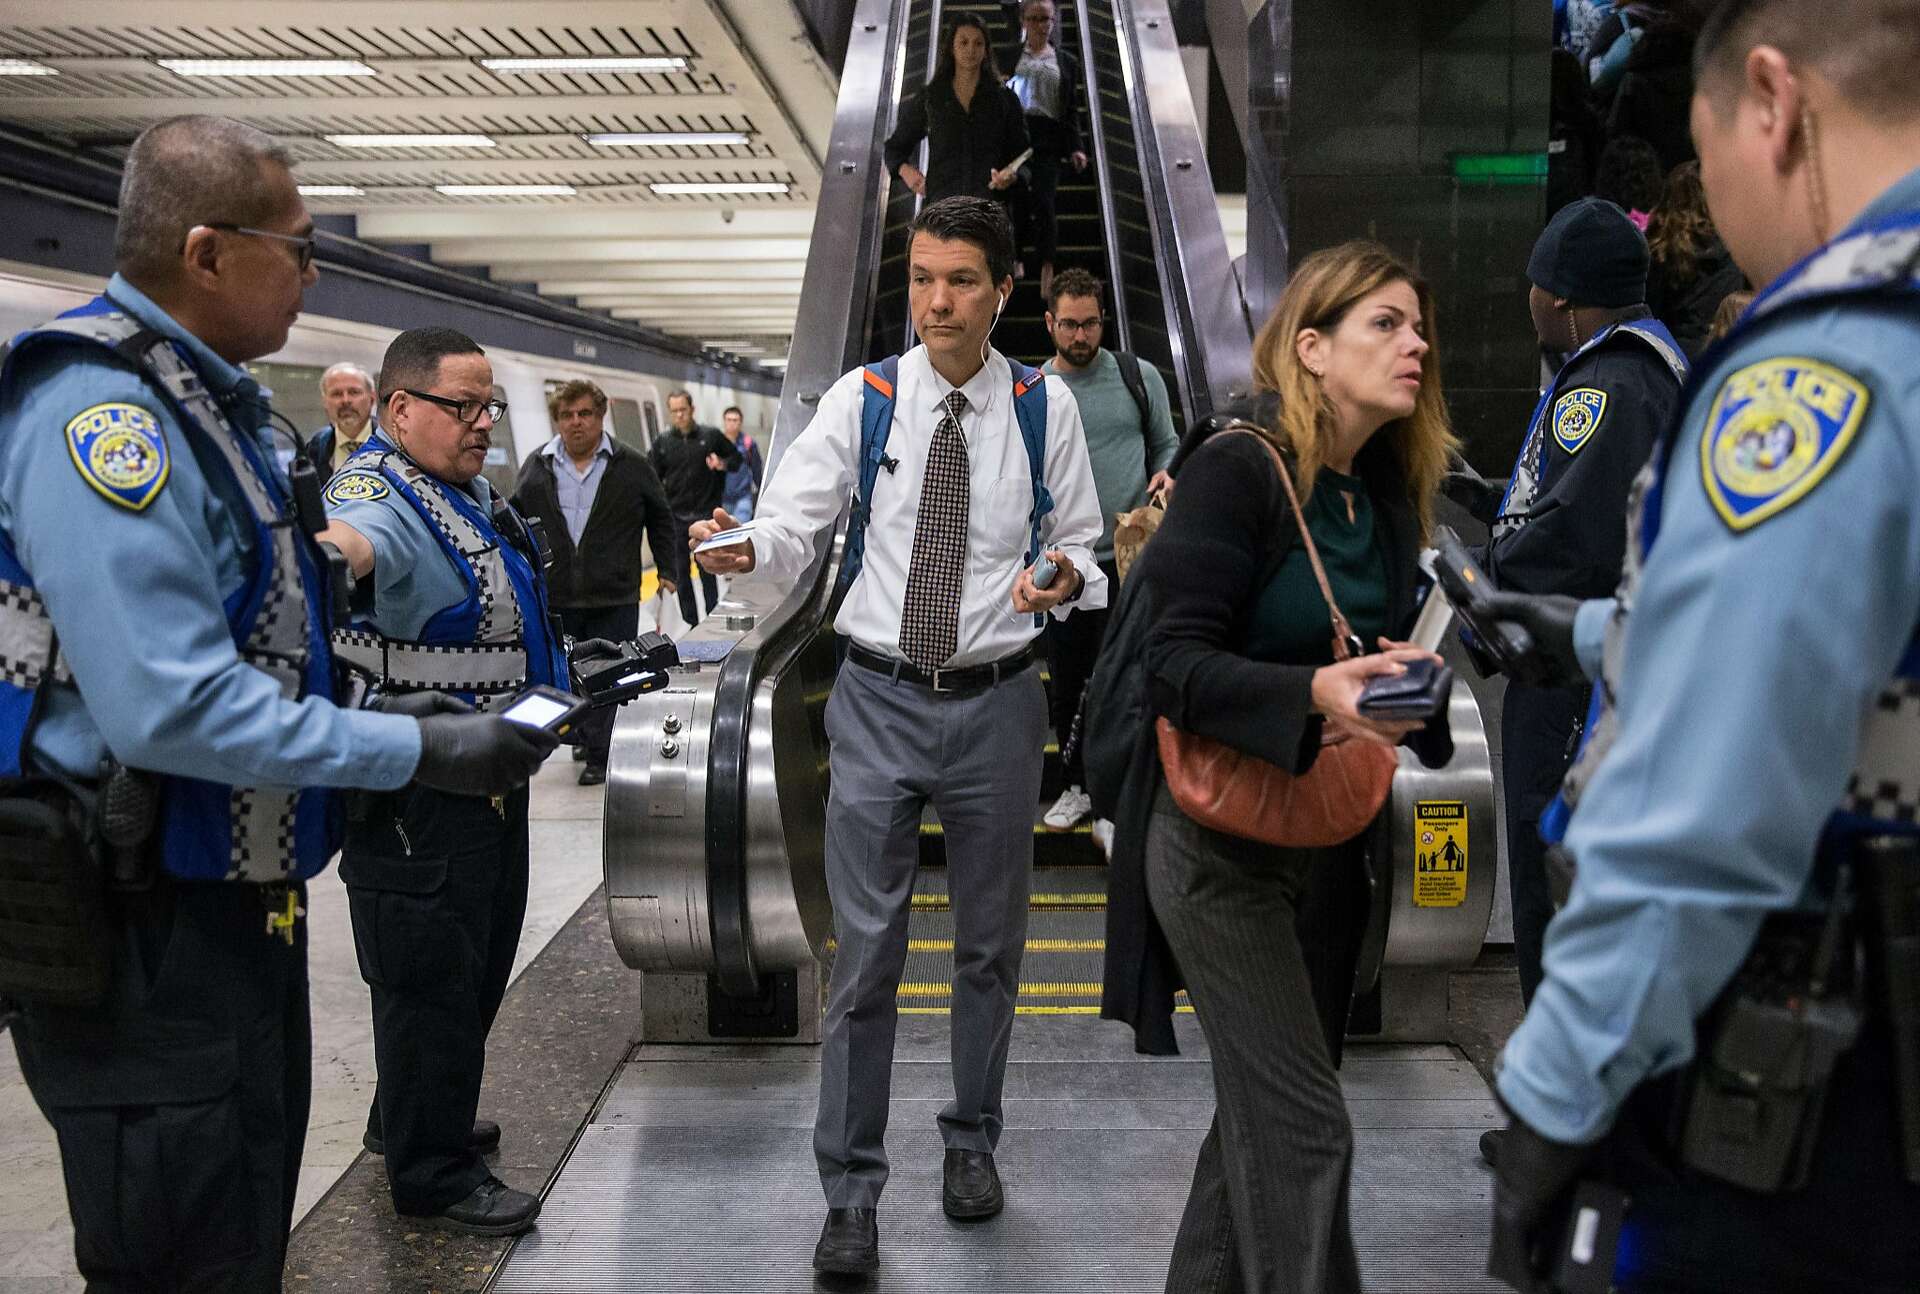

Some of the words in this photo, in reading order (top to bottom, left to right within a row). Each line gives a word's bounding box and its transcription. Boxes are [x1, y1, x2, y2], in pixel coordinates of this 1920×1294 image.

[1558, 392, 1600, 412] POLICE
[1722, 367, 1847, 422] POLICE
[75, 408, 160, 445] POLICE
[1421, 806, 1459, 816] CAUTION
